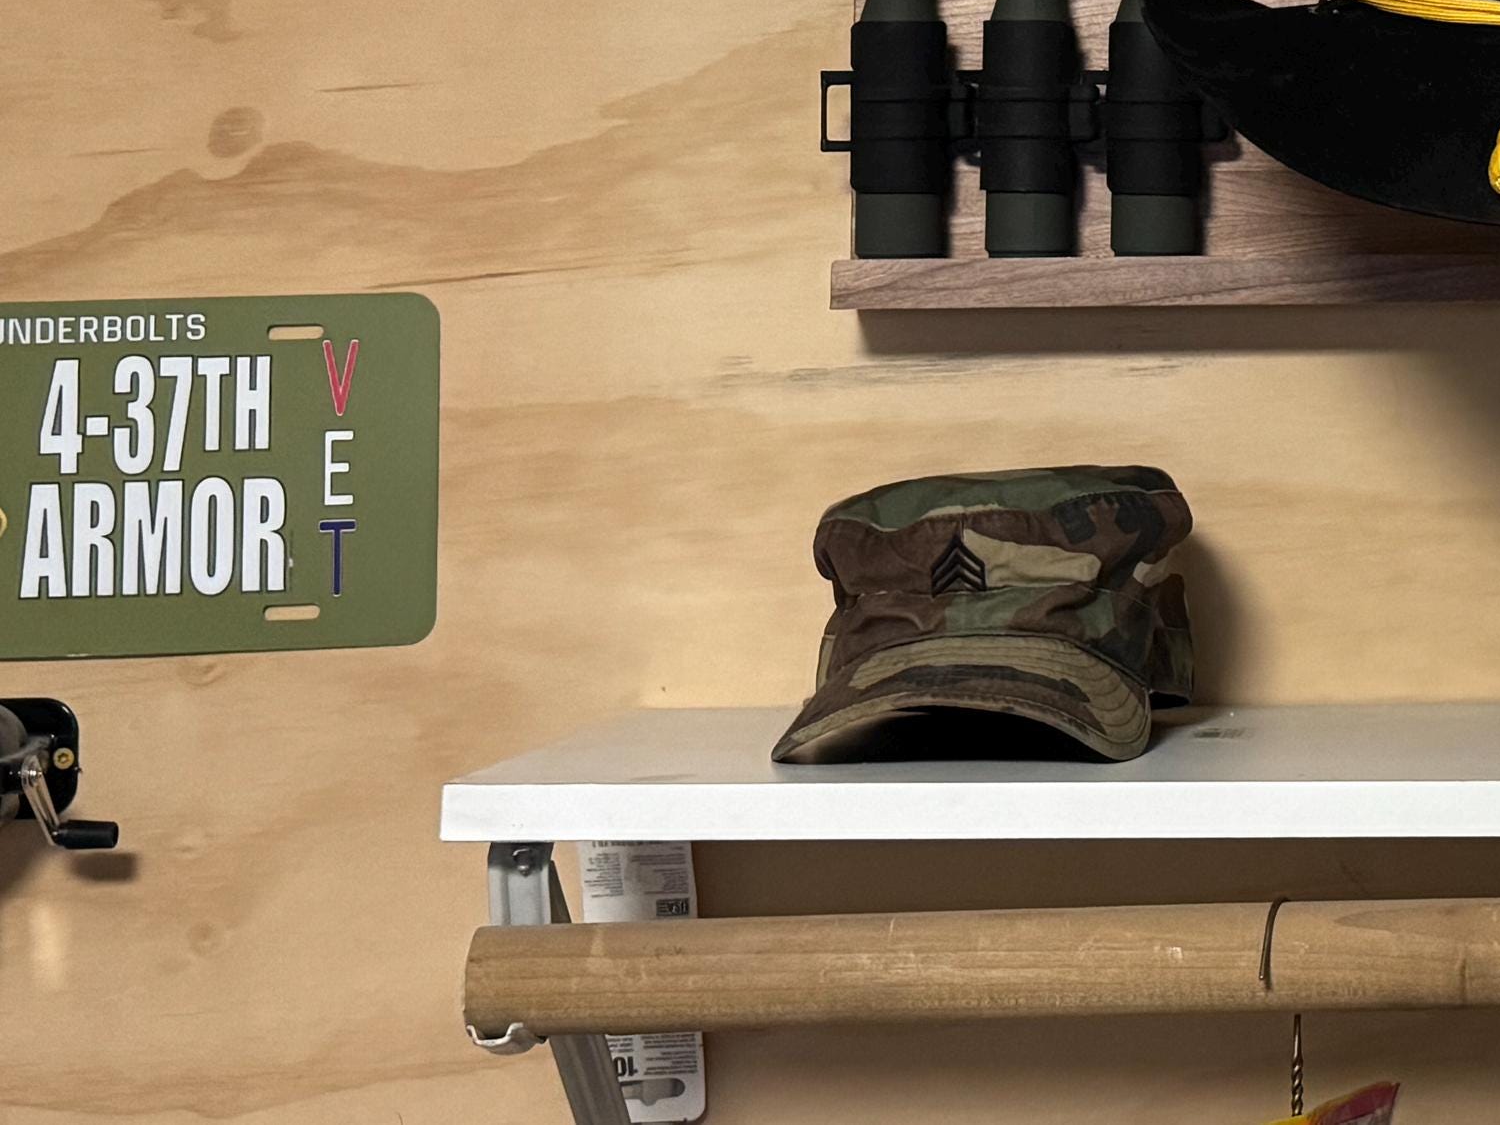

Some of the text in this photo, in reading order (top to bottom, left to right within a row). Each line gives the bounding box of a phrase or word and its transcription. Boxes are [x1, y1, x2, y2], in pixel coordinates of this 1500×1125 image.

[0, 313, 206, 345] NDERBOLTS
[38, 355, 272, 475] 4-37TH
[18, 476, 288, 599] ARMOR
